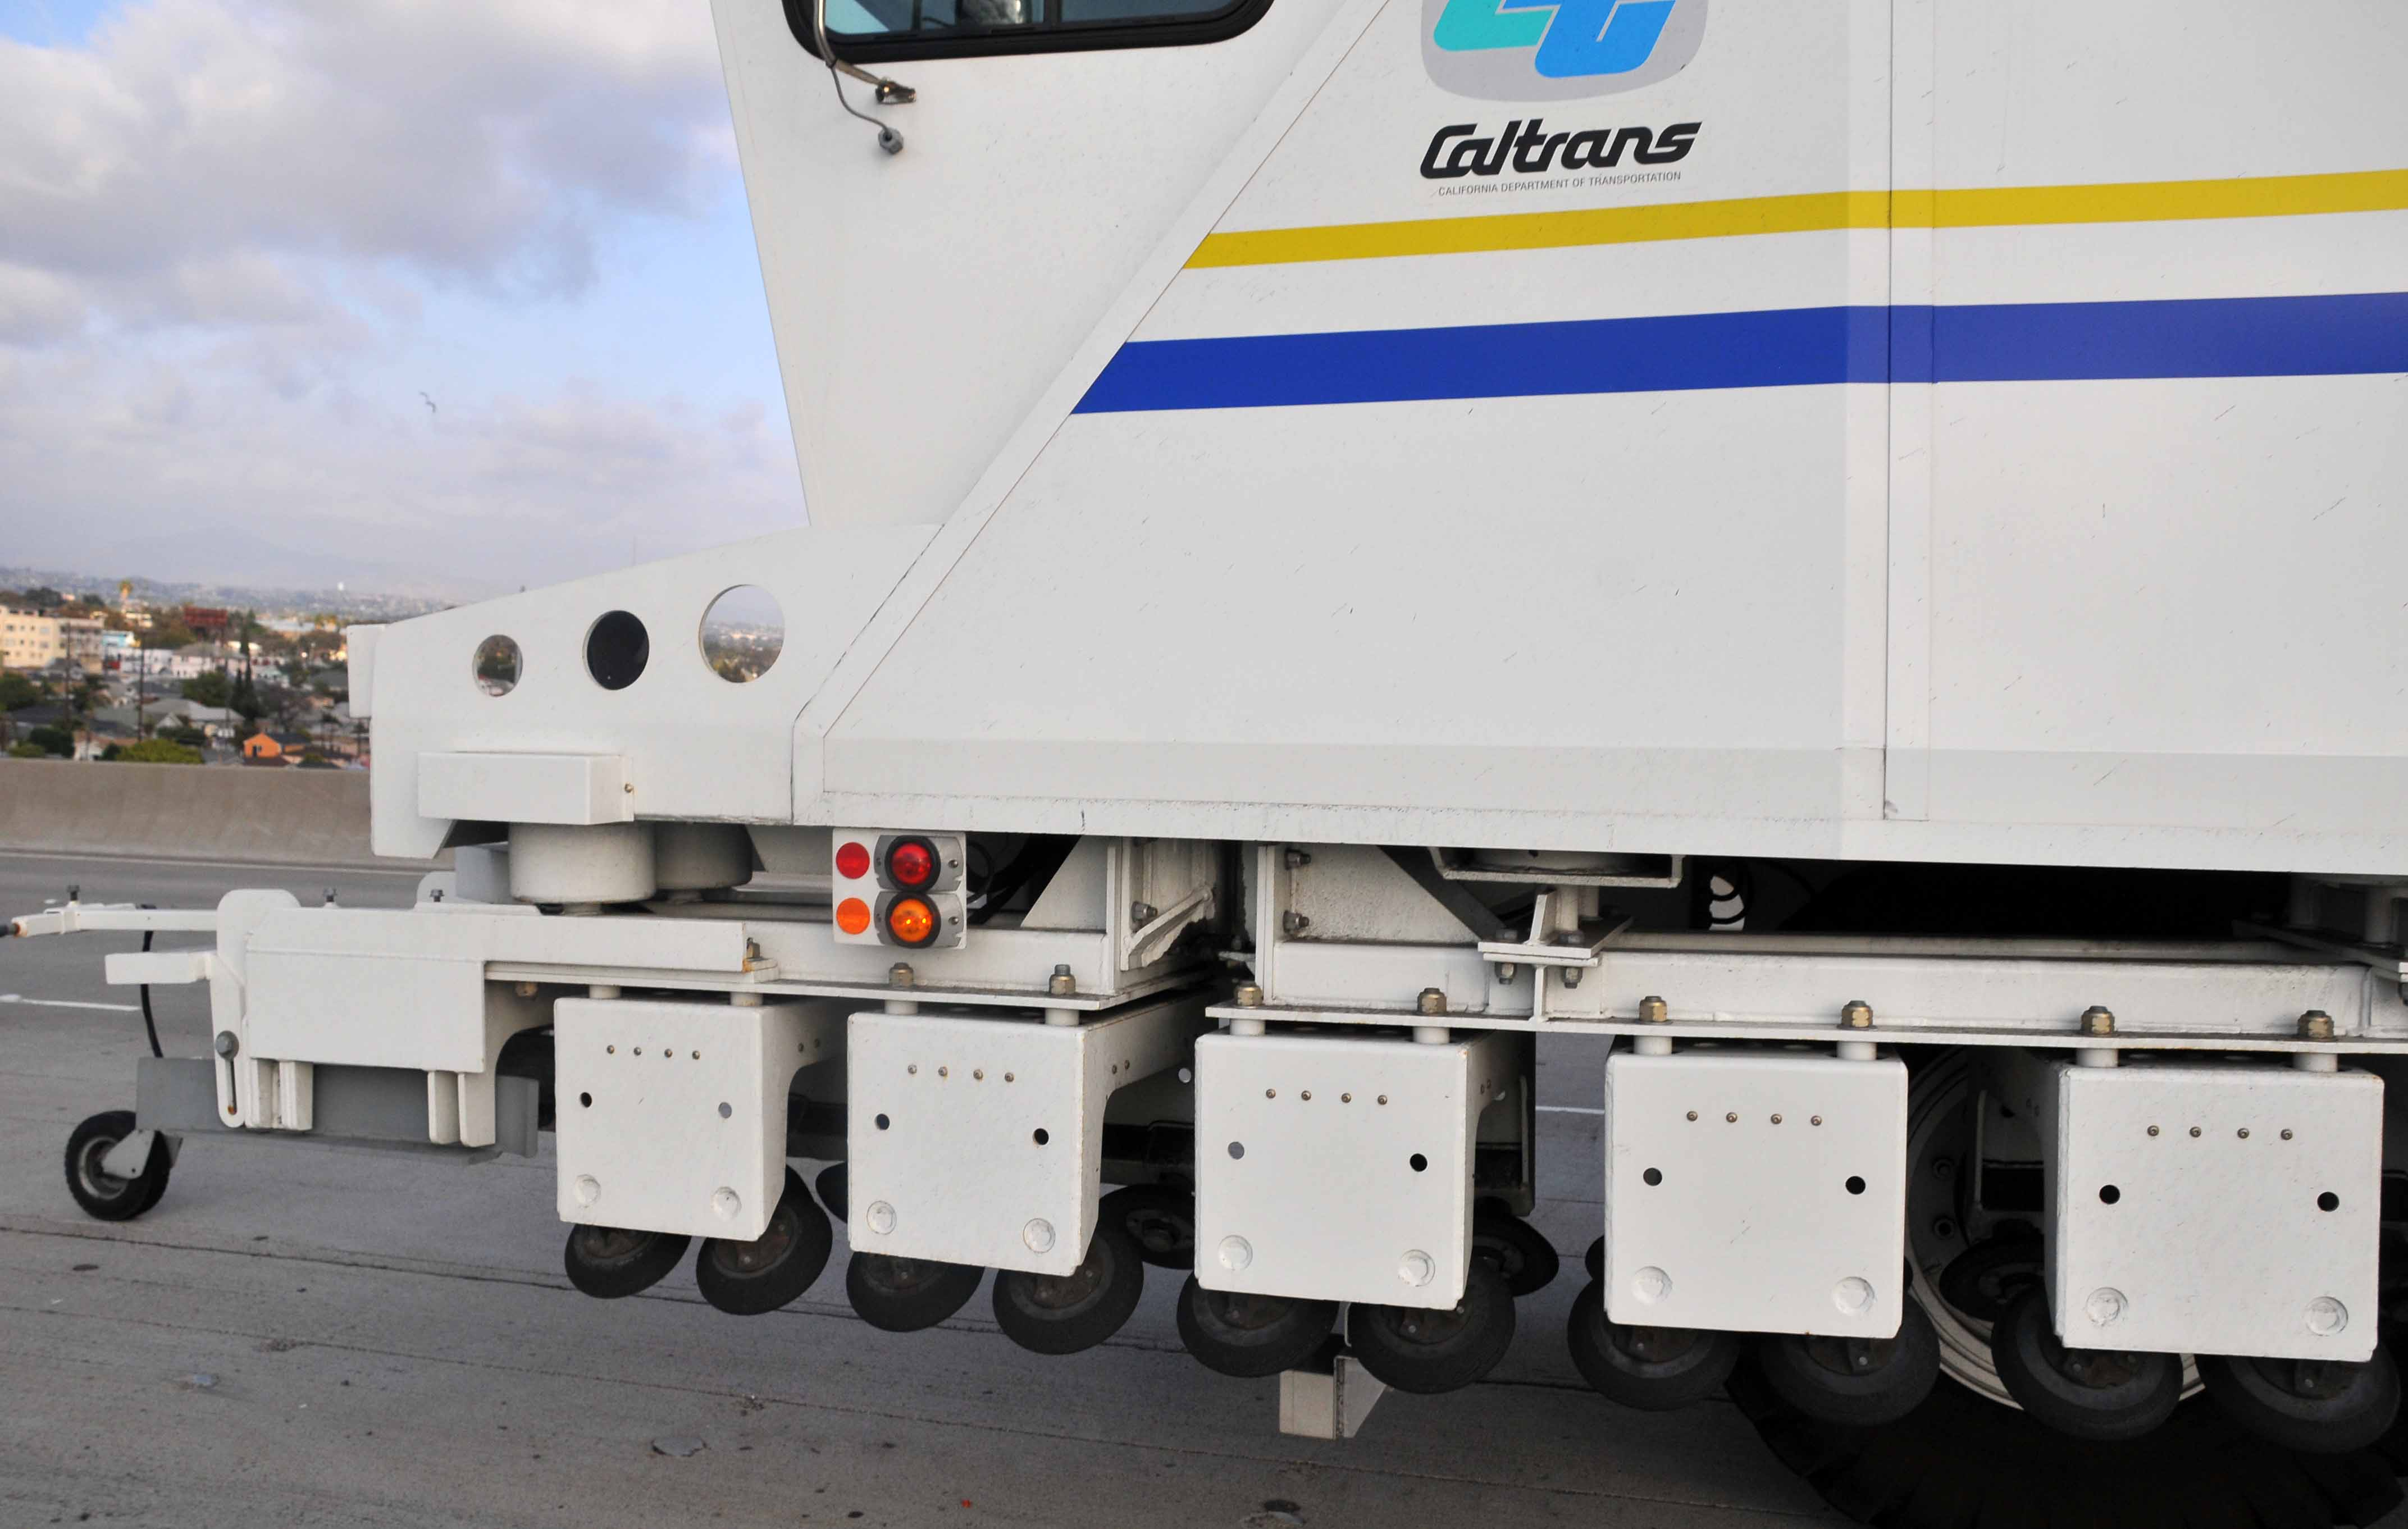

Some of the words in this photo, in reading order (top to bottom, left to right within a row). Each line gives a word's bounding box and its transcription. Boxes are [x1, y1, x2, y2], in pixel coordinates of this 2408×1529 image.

[1420, 118, 1702, 179] Caltrans
[1438, 183, 1498, 197] CALIFORNIA
[1501, 179, 1568, 192] DEPARTMENT
[1572, 177, 1585, 188] OF
[1590, 171, 1681, 186] TRANSPORTATION
